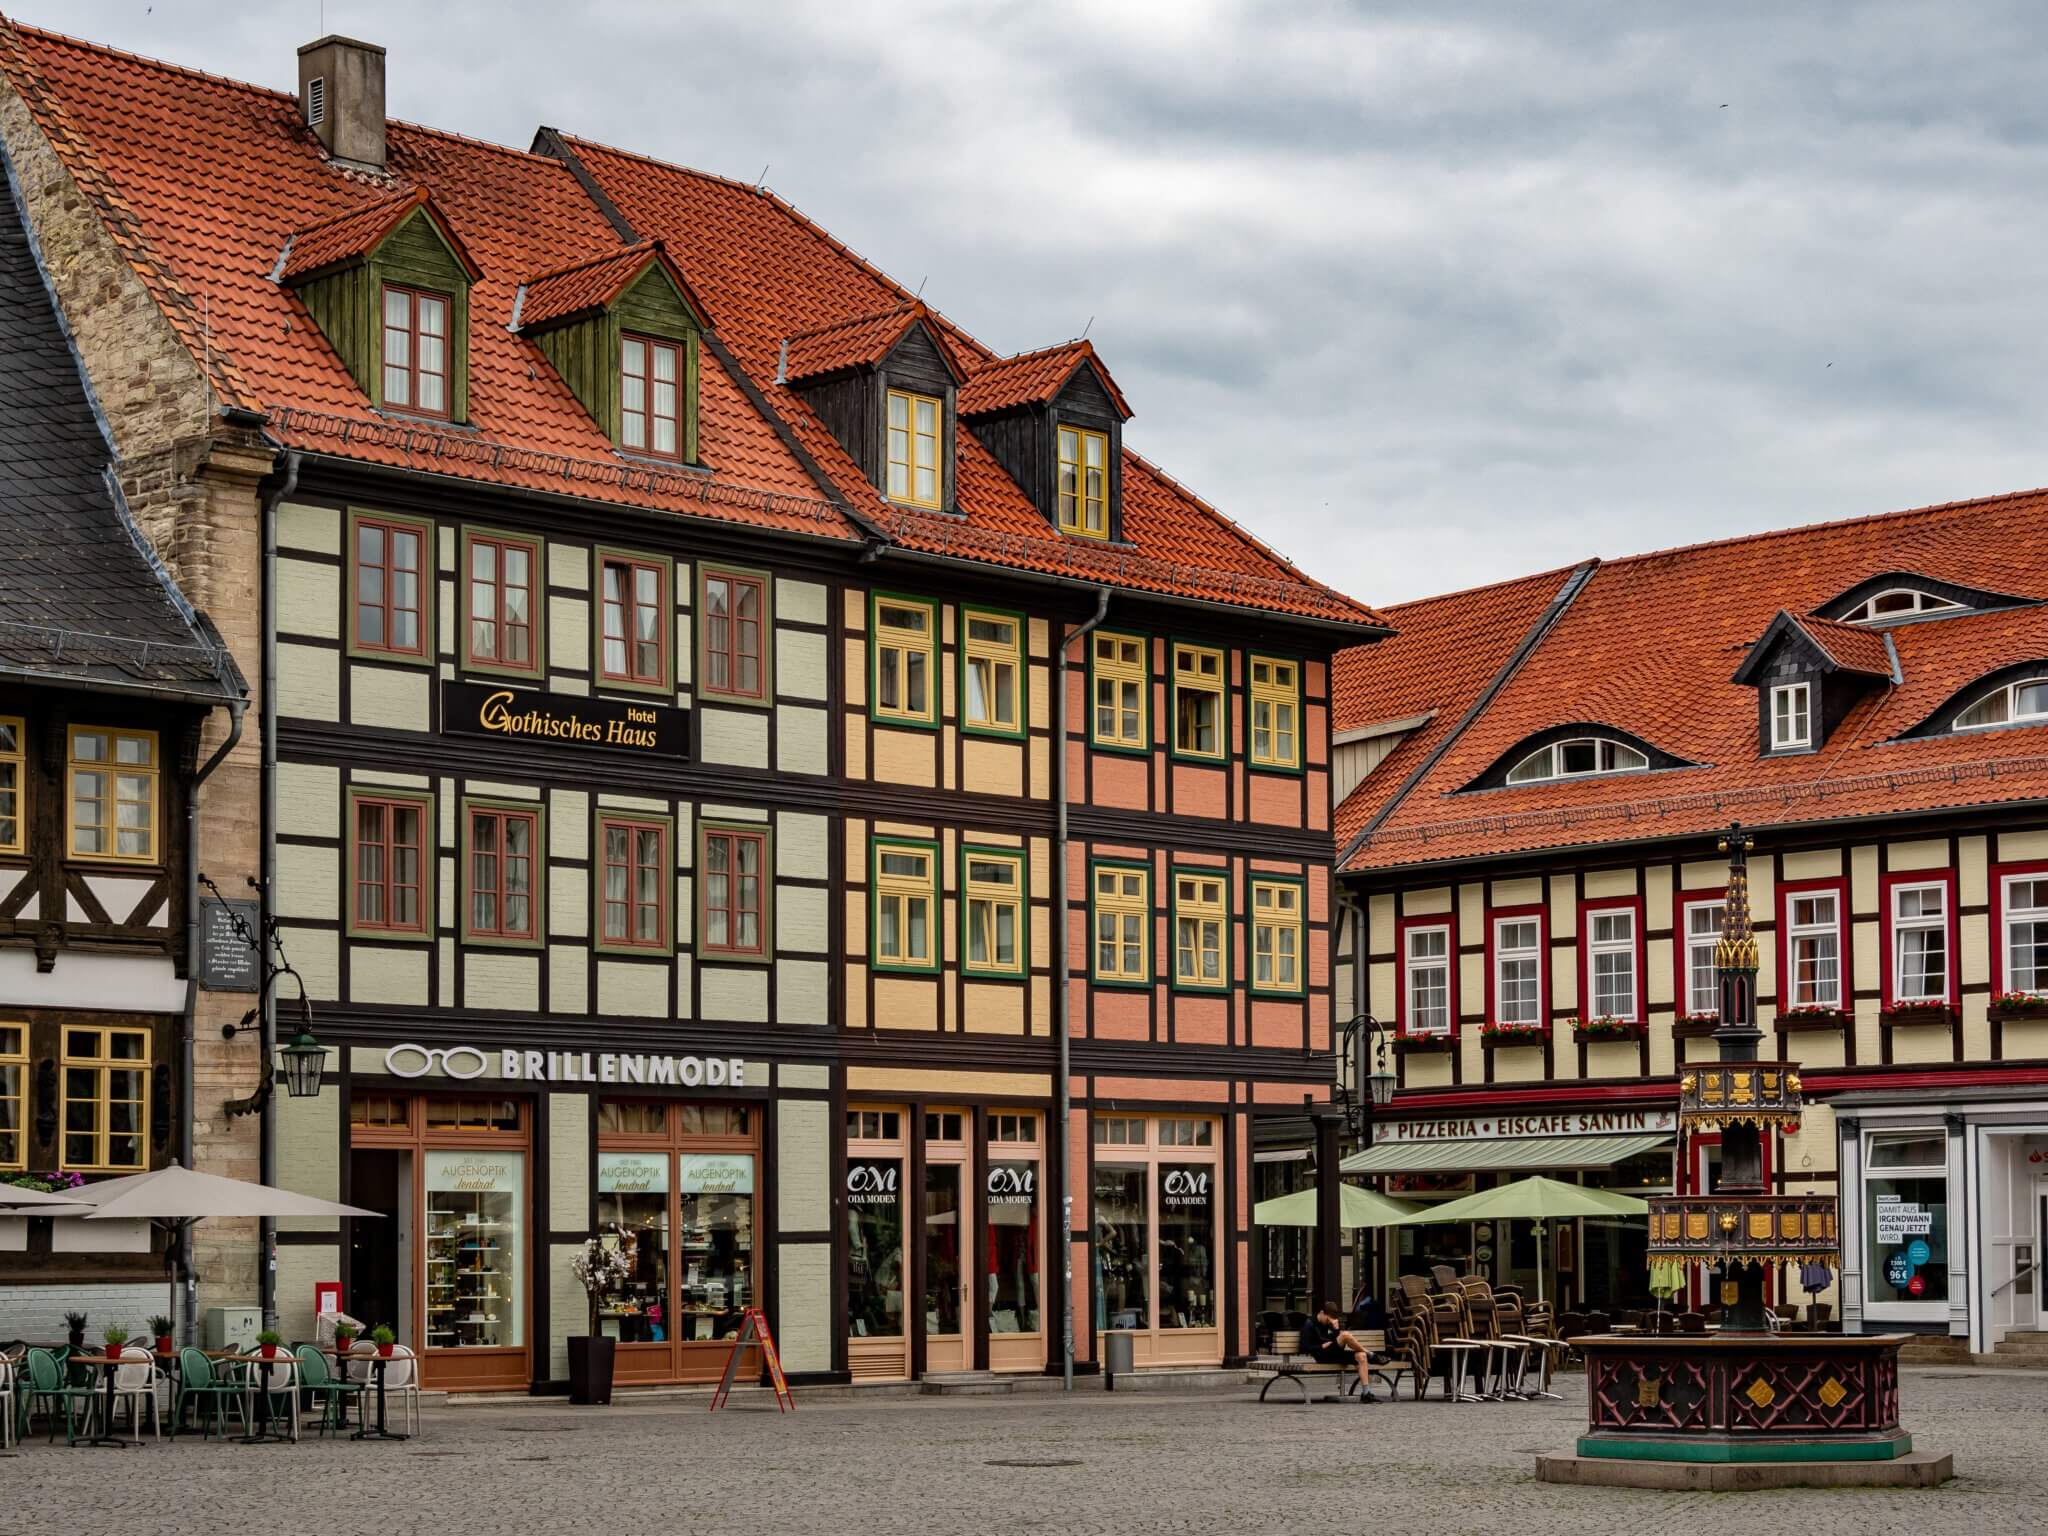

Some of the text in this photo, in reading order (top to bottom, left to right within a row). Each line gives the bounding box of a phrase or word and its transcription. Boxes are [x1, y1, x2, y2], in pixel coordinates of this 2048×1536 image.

[479, 691, 657, 748] Gothisches Haus
[628, 707, 657, 724] Hotel
[501, 1048, 745, 1087] BRILLENMODE
[1398, 1119, 1477, 1139] PIZZERIA
[1497, 1115, 1571, 1135] EISCAFE
[1578, 1111, 1646, 1131] SANTIN
[441, 1165, 508, 1177] AUGENOPTIK
[600, 1167, 661, 1178] AUGENOPTIK
[688, 1168, 747, 1179] AUGENOPTIK
[847, 1194, 896, 1204] ODA MODEN
[988, 1195, 1032, 1204] ODA MODEN
[1165, 1196, 1207, 1205] ODA MODEN
[1879, 1206, 1917, 1214] DAMIT AUS
[1879, 1215, 1930, 1223] IRGENDWANN
[1880, 1224, 1927, 1232] GENAU JETZT
[1889, 1270, 1901, 1280] 96
